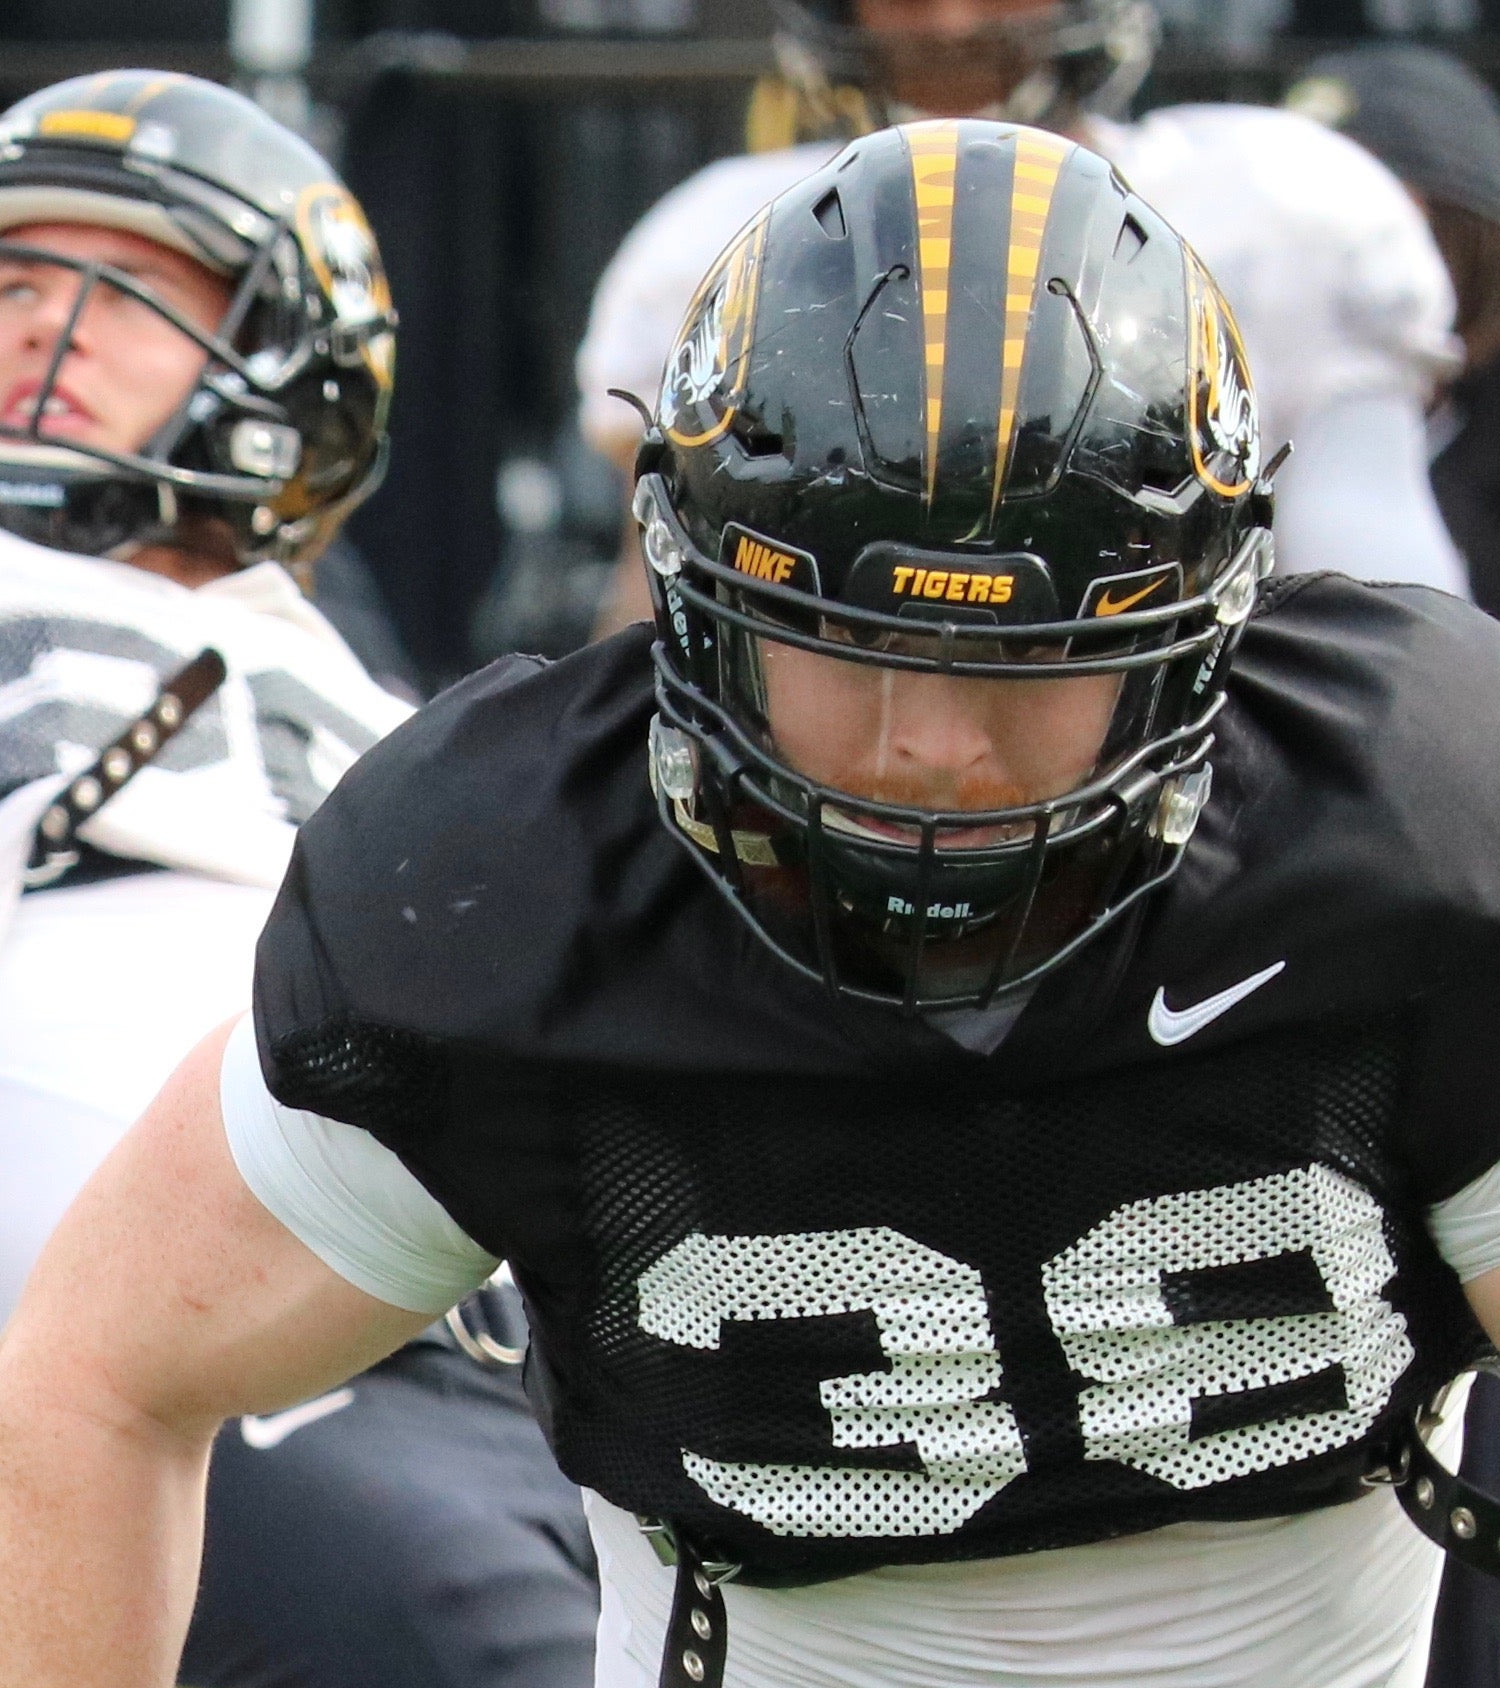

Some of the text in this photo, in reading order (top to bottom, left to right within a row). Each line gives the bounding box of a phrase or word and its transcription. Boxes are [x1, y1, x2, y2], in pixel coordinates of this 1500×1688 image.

[735, 536, 796, 583] NIKE
[893, 566, 1014, 603] TIGERS
[888, 896, 970, 918] Ridell
[637, 1162, 1415, 1537] 38
